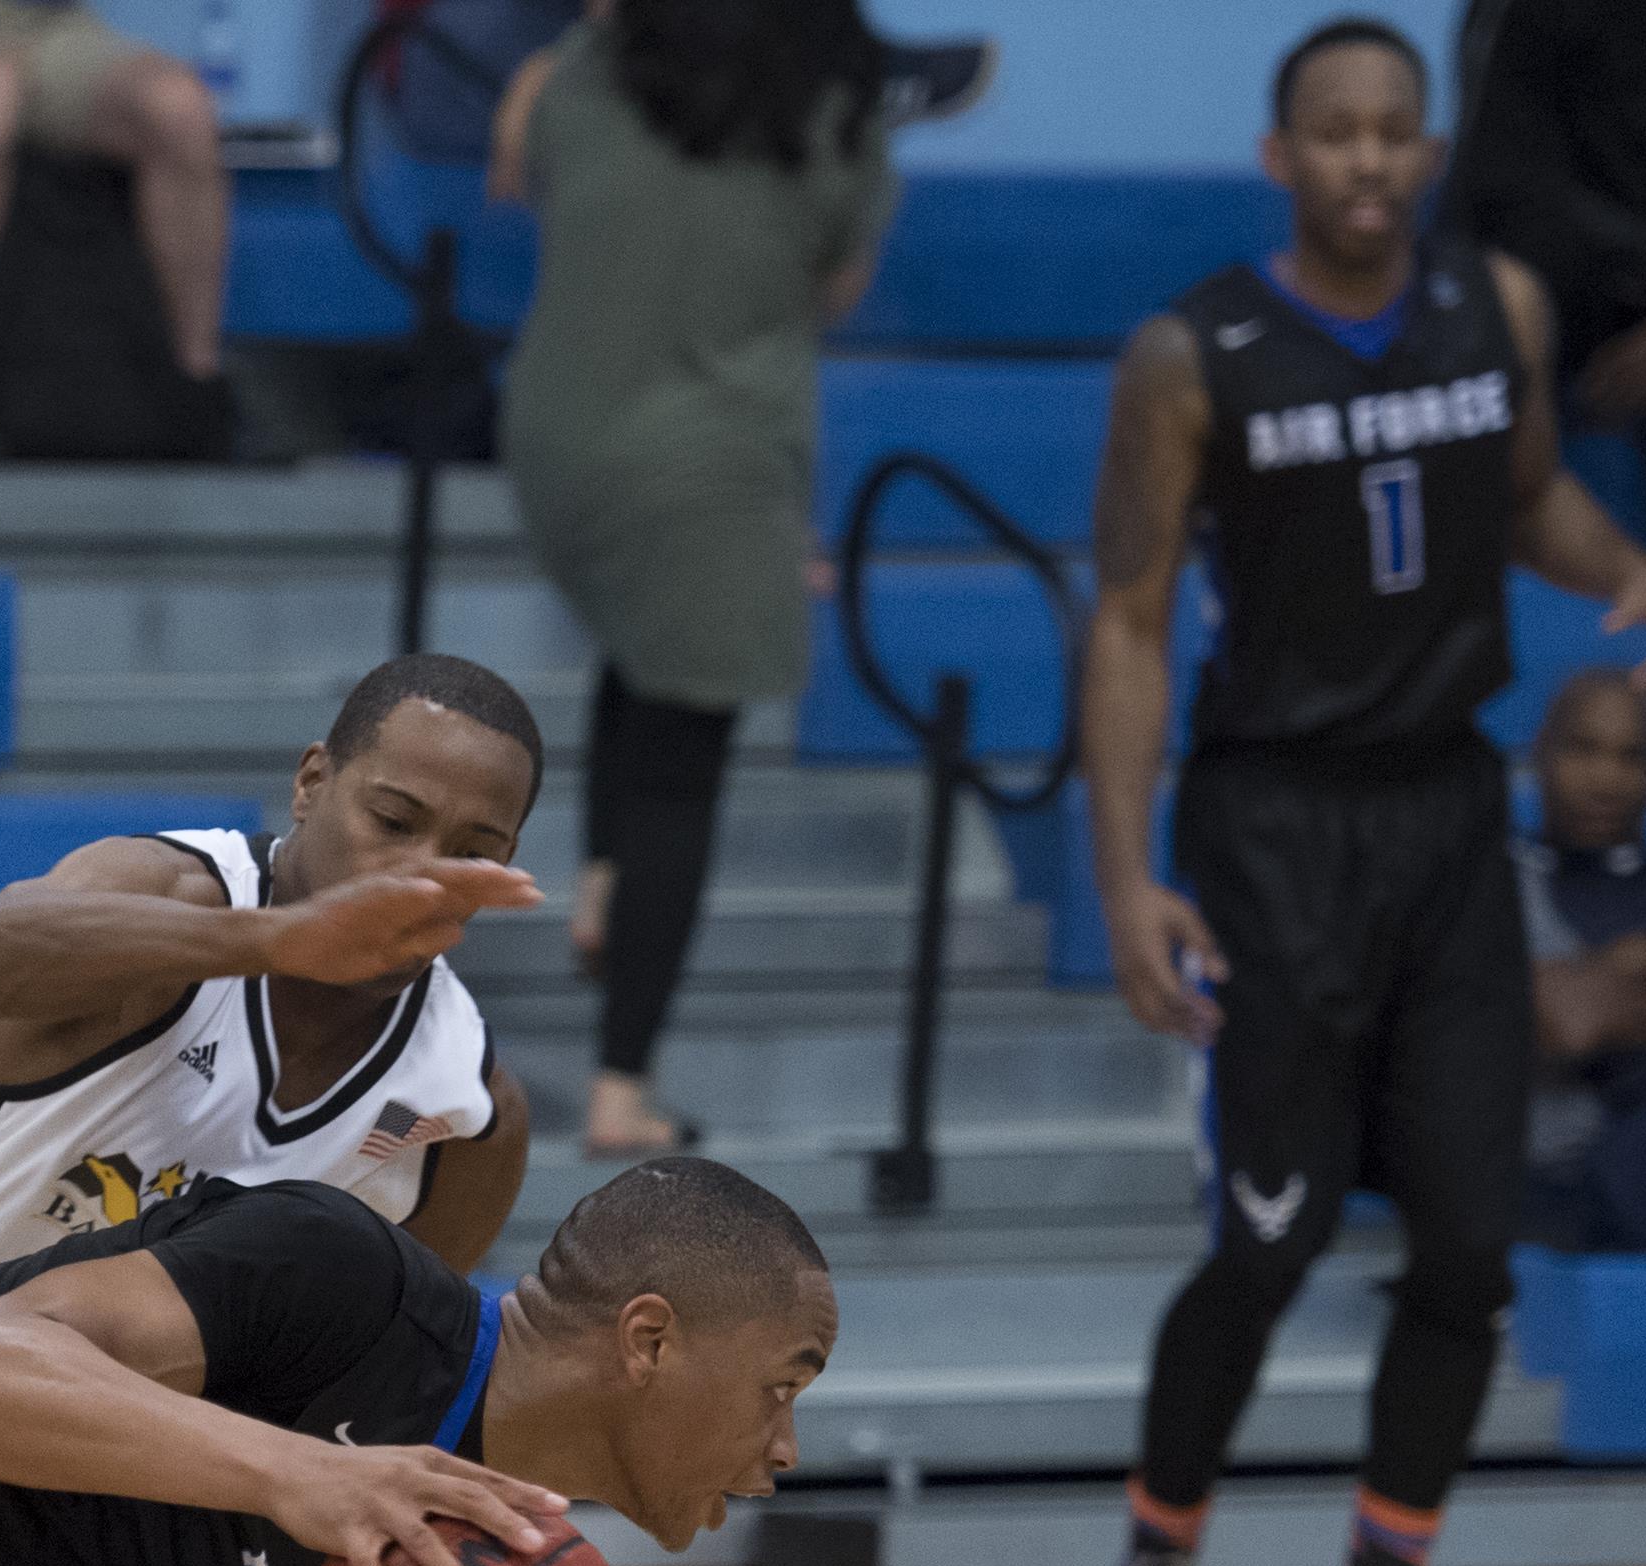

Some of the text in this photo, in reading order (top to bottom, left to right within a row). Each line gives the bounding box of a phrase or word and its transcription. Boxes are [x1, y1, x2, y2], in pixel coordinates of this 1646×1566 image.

[1249, 370, 1510, 471] AIR FORCE
[1360, 458, 1426, 595] 1
